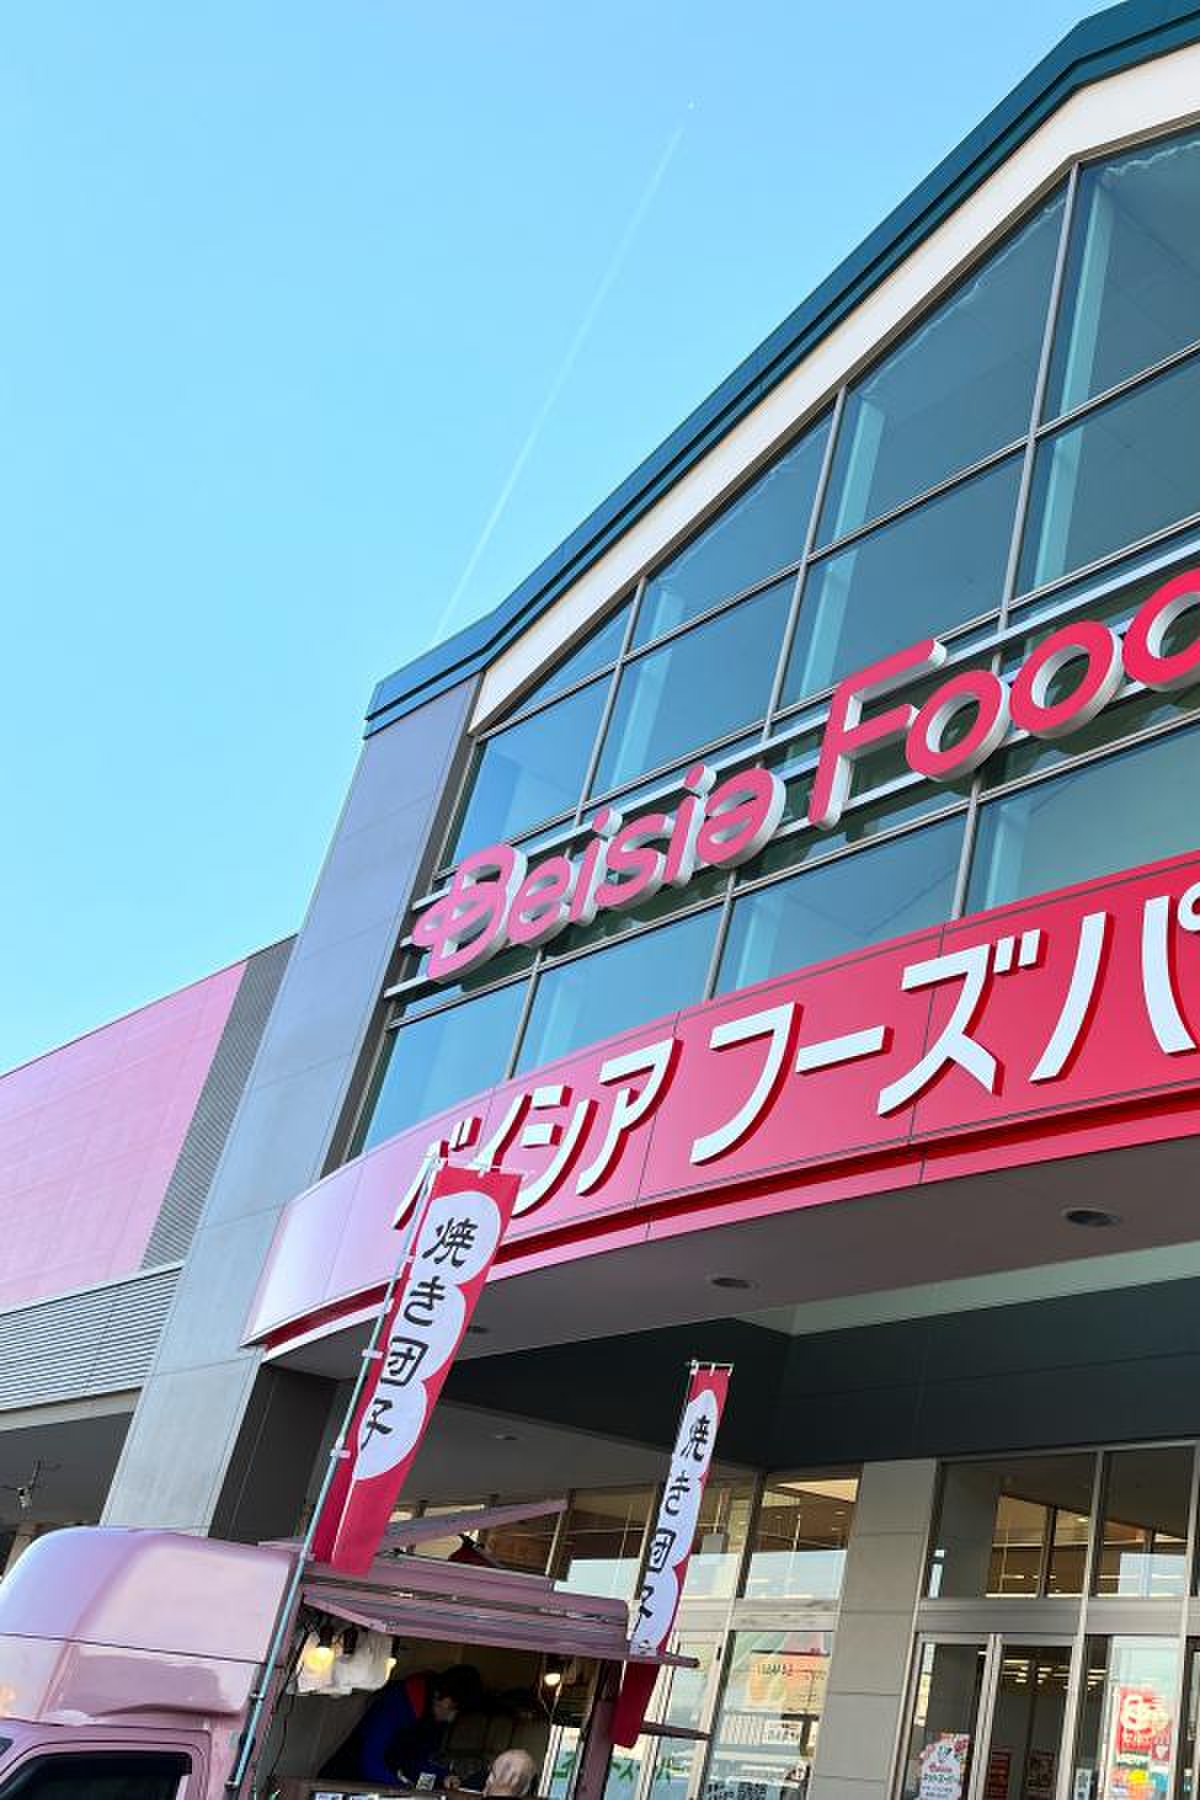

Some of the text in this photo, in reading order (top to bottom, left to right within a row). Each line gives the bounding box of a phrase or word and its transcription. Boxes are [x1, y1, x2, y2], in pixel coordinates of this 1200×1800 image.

[410, 764, 787, 983] Beisia
[360, 1216, 479, 1449] 焼き団子
